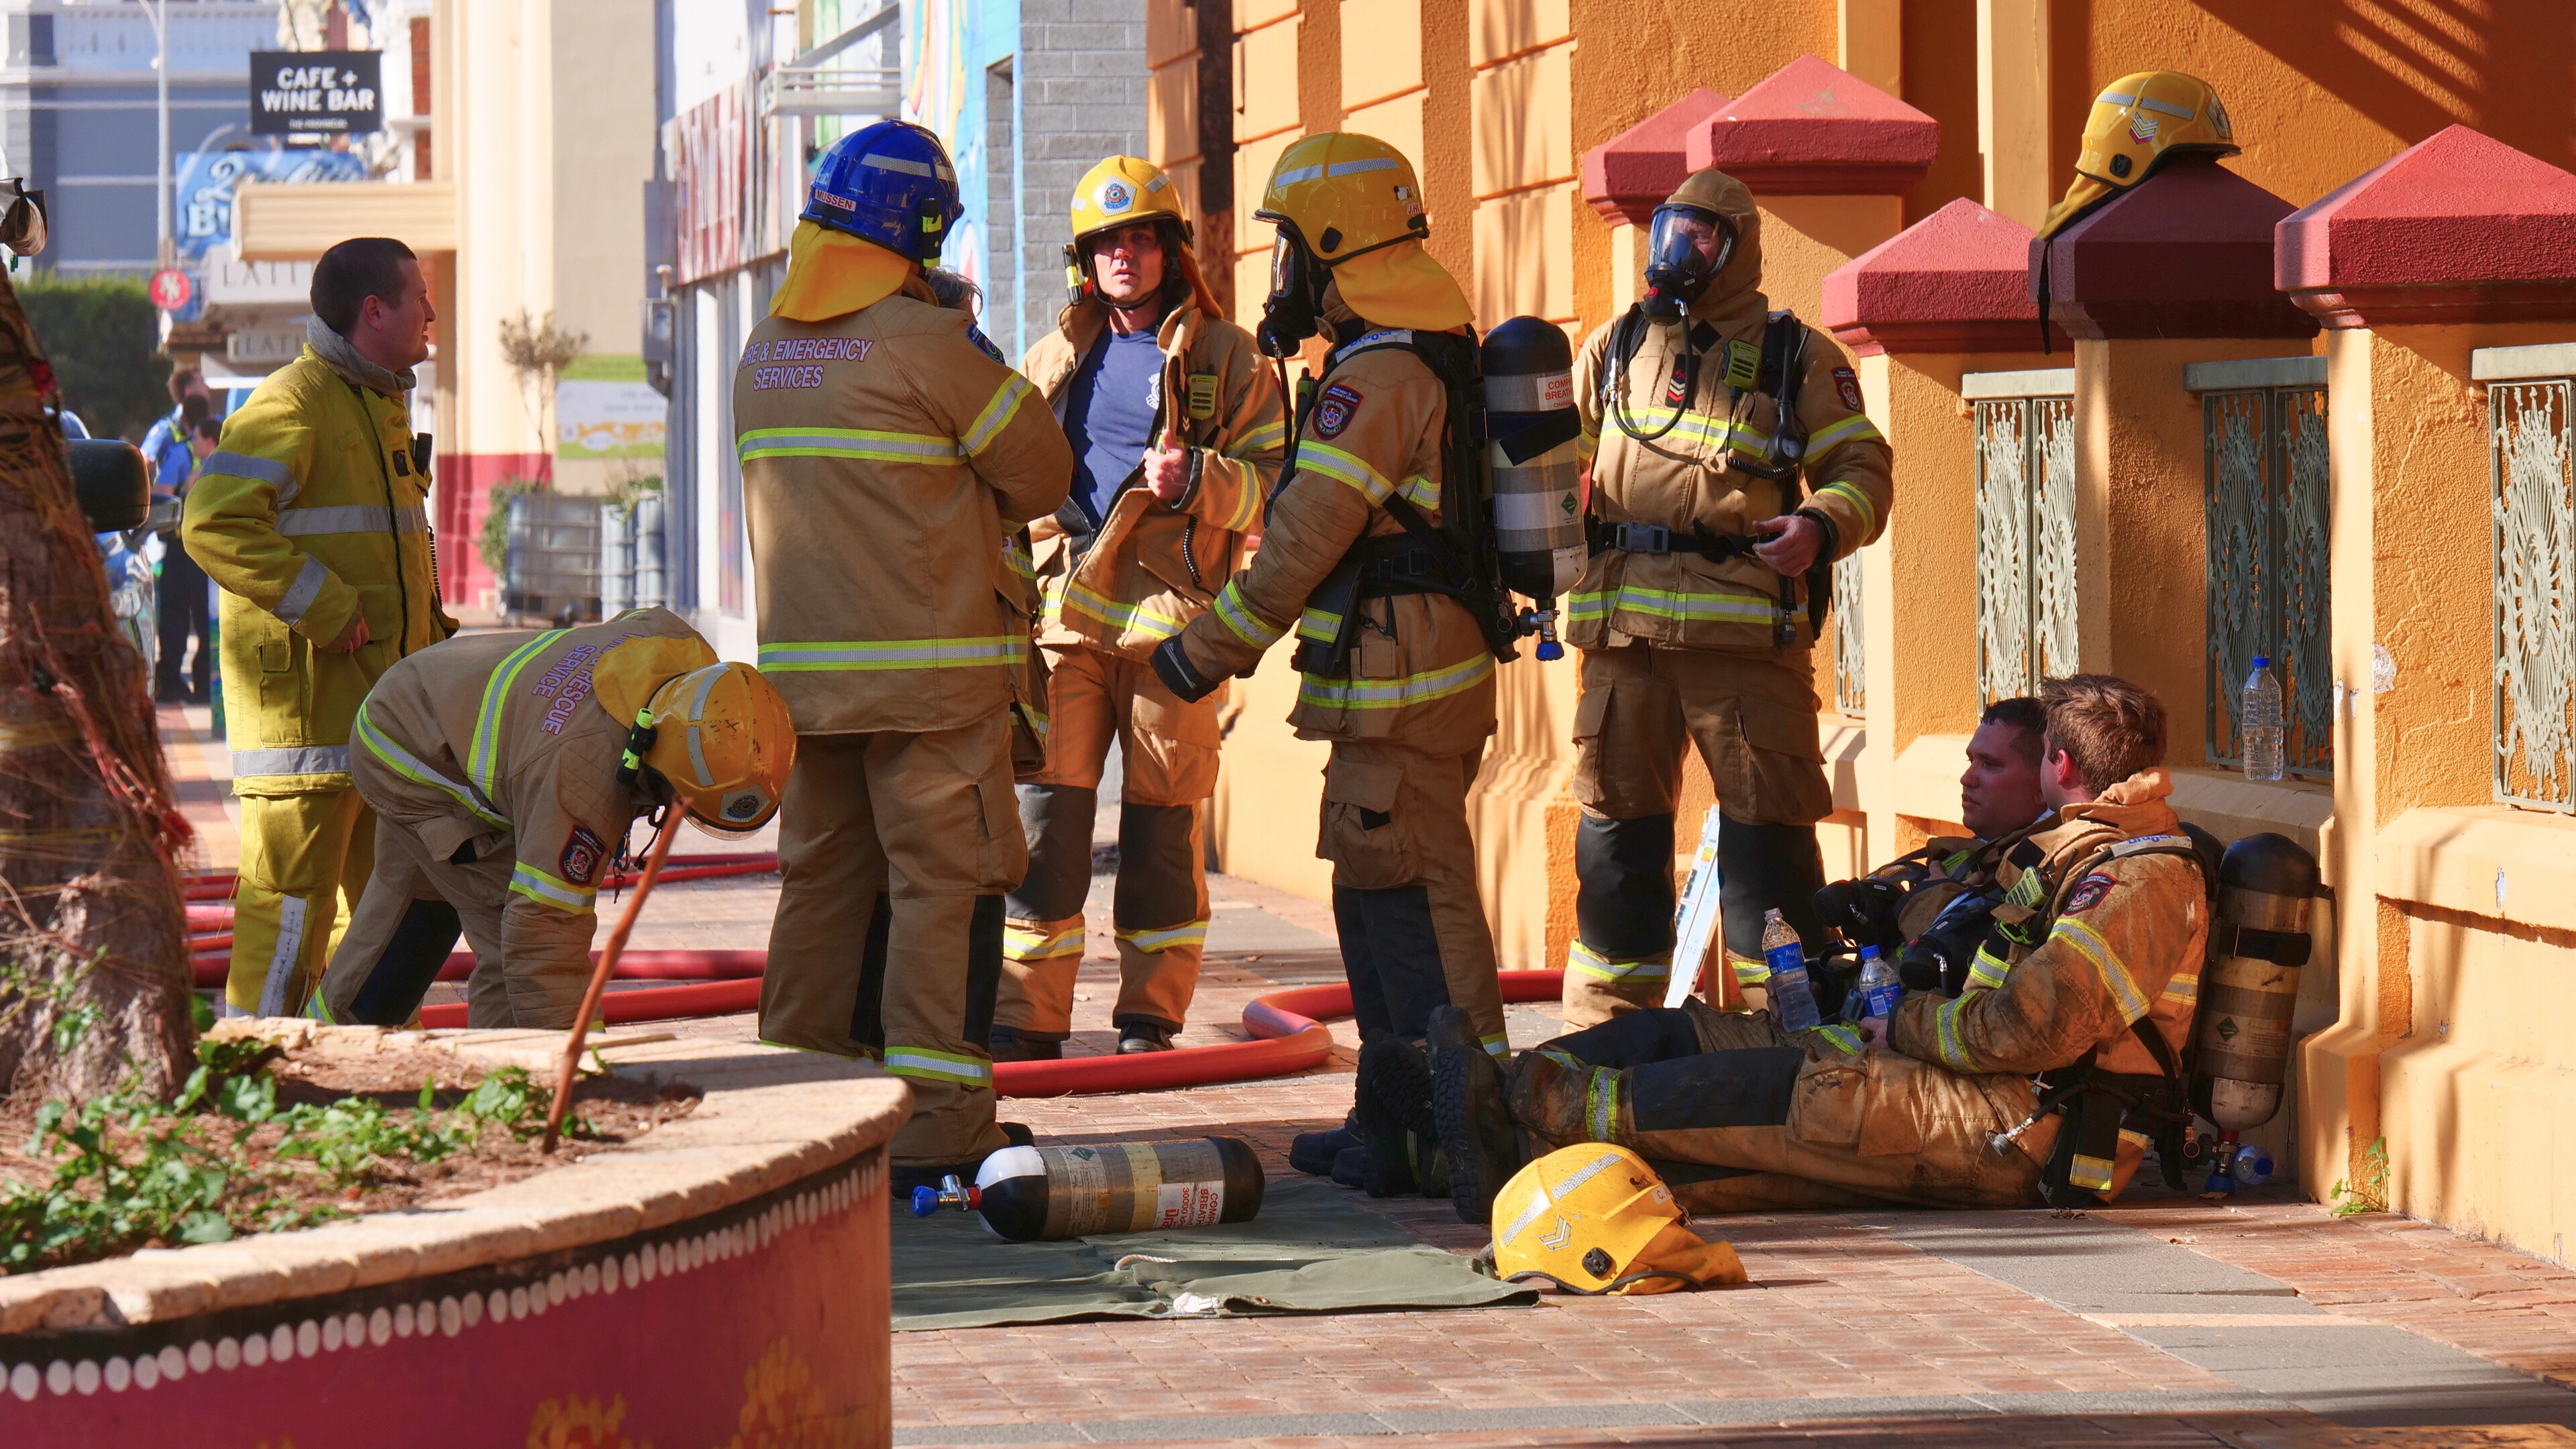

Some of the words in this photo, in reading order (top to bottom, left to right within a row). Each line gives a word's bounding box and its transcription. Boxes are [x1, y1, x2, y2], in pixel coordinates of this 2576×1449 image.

[277, 66, 337, 90] CAFE
[341, 70, 358, 87] +
[261, 89, 322, 112] WINE
[327, 88, 375, 111] BAR
[817, 190, 853, 209] MUSSEN
[759, 340, 771, 362] &
[771, 337, 875, 362] EMERGENCY
[753, 365, 824, 391] SERVICES
[531, 644, 597, 698] SERVICE
[539, 669, 592, 735] RESCUE
[1181, 1187, 1189, 1214] 30000
[1195, 1189, 1208, 1226] BREATH
